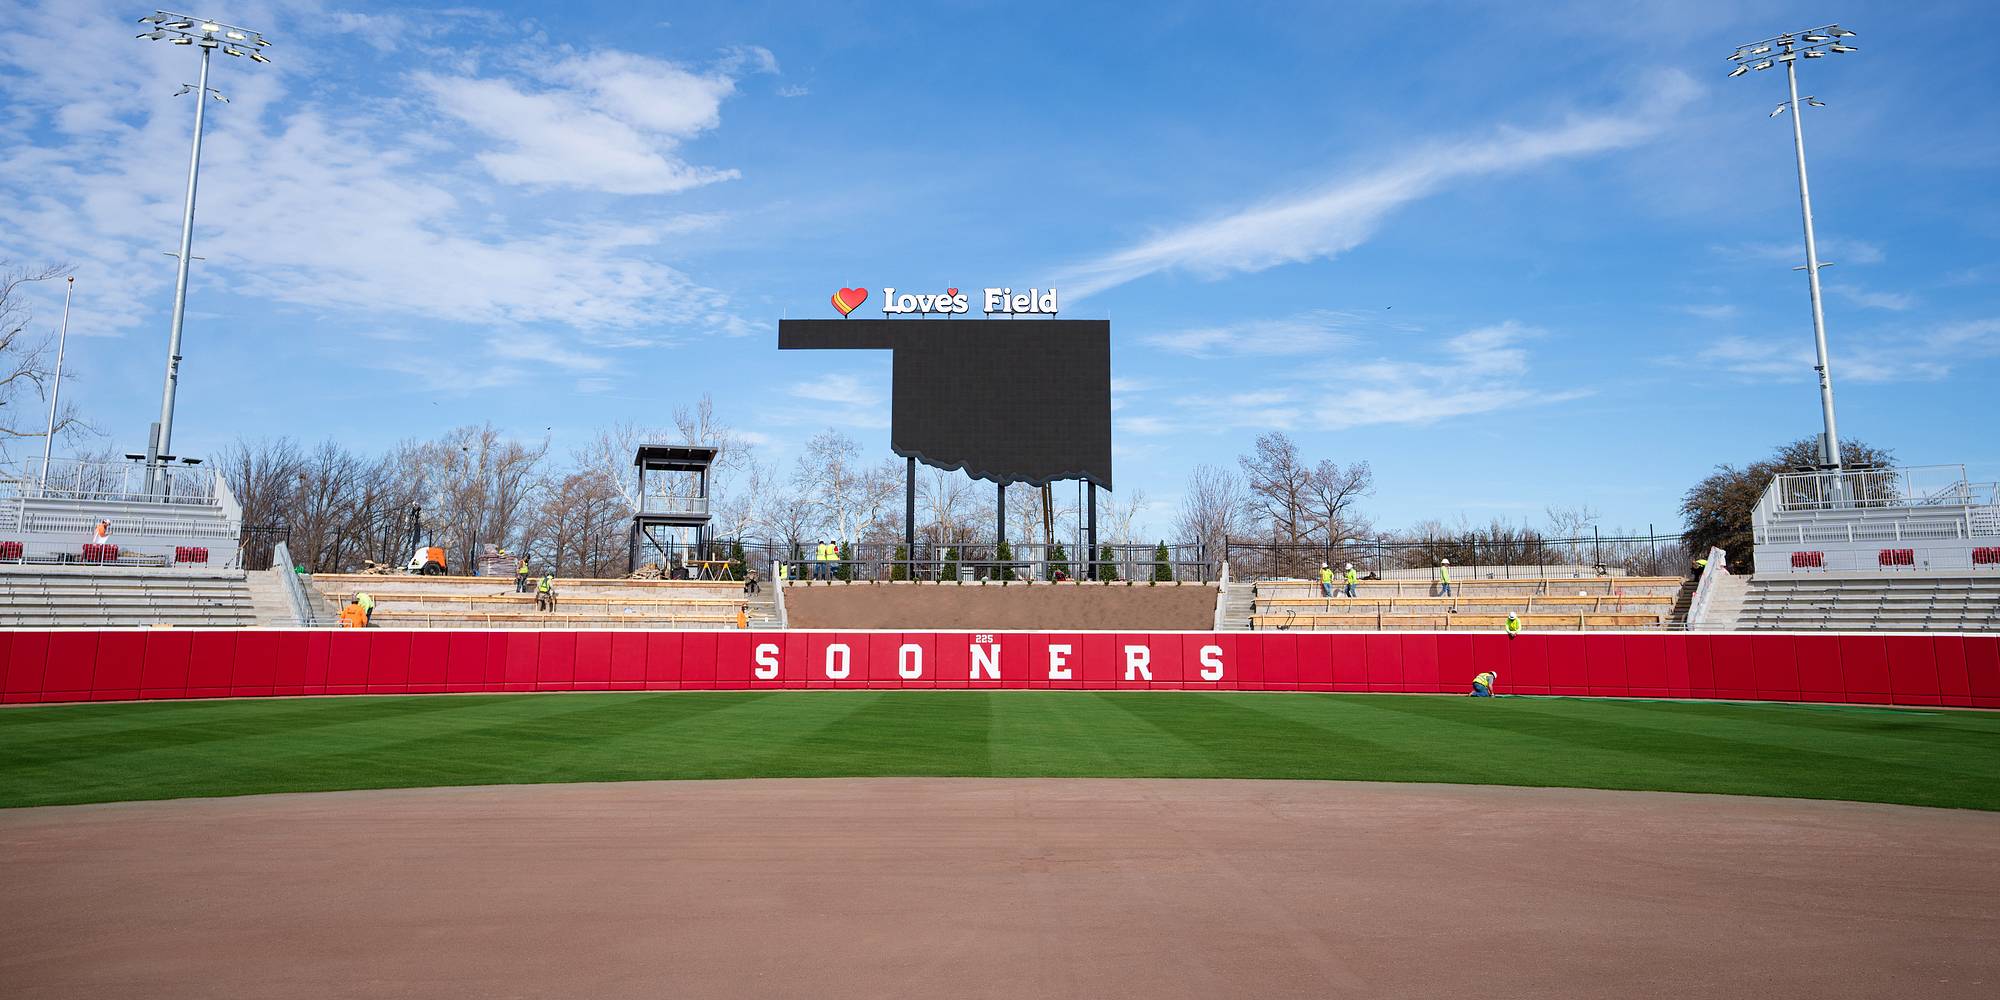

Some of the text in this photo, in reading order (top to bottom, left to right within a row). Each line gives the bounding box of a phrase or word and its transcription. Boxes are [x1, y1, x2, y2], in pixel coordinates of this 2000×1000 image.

[983, 287, 1058, 313] Field
[975, 634, 994, 644] 225
[754, 643, 1225, 681] SOONERS
